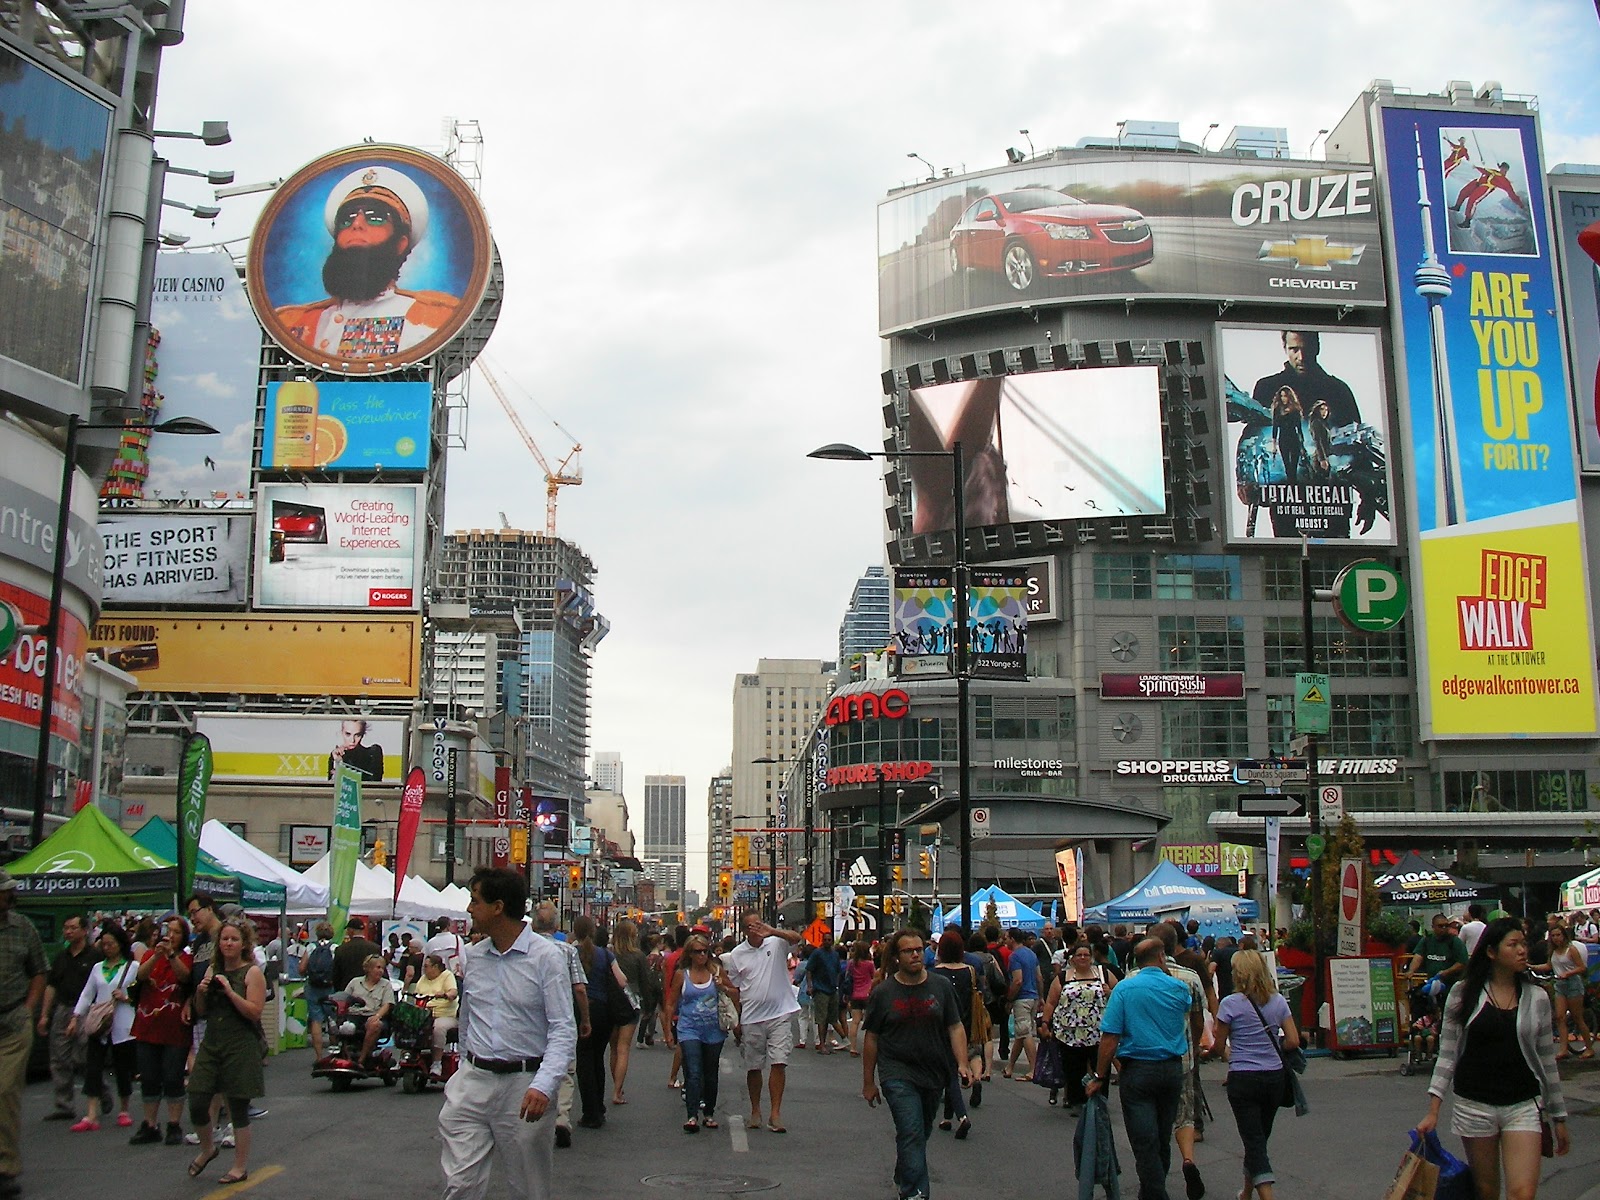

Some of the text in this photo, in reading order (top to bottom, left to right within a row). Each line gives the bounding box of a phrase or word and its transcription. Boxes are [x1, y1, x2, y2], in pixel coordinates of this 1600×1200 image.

[1231, 172, 1373, 227] CRUZE
[182, 277, 225, 293] CASINO
[1268, 277, 1359, 290] CHEVROLET
[184, 294, 222, 302] FALLS
[1470, 271, 1533, 318] ARE
[1470, 320, 1539, 367] YOU
[330, 394, 385, 412] Pass the
[1477, 368, 1543, 441] UP
[1484, 443, 1550, 471] FOR IT?
[1259, 484, 1356, 505] TOTAL RECALL
[350, 499, 394, 514] Creating
[1277, 506, 1284, 515] IS
[1284, 506, 1290, 515] IT
[1309, 506, 1317, 515] IS
[1317, 506, 1323, 515] IT
[1323, 506, 1344, 516] RECALL
[334, 512, 410, 527] World-Leading
[1295, 518, 1329, 529] AUGUST 3
[102, 525, 217, 550] THE SPORT
[351, 525, 391, 536] Internet
[340, 537, 401, 551] Experiences.
[103, 546, 218, 570] OF FITNESS
[102, 566, 218, 588] HAS ARRIVED.
[370, 566, 389, 575] speeds
[1486, 553, 1543, 605] EDGE
[381, 592, 407, 600] ROGERS
[1355, 569, 1398, 614] P
[1460, 600, 1528, 648] WALK
[90, 624, 159, 642] KEYS FOUND:
[977, 659, 1022, 669] 322 Yonge St.
[1487, 651, 1546, 666] AT THE CN TOWER
[1139, 675, 1206, 697] spring sushi
[1301, 675, 1327, 685] NOTICE
[1441, 674, 1580, 700] edgewalkcntower.ca
[276, 755, 321, 771] XXI
[994, 756, 1063, 769] milestones
[1116, 760, 1230, 774] SHOPPERS
[1338, 759, 1398, 774] FITNESS
[448, 751, 456, 799] DOWNTOWN
[880, 761, 933, 782] SHOP
[1163, 774, 1230, 782] DRUG MART
[1247, 769, 1298, 780] Dundas Square
[1204, 863, 1219, 873] DIP
[35, 875, 121, 893] zipcar.com
[1160, 884, 1206, 896] TORONTO
[1390, 888, 1478, 901] Today's Best Music
[1372, 1002, 1395, 1011] WIN
